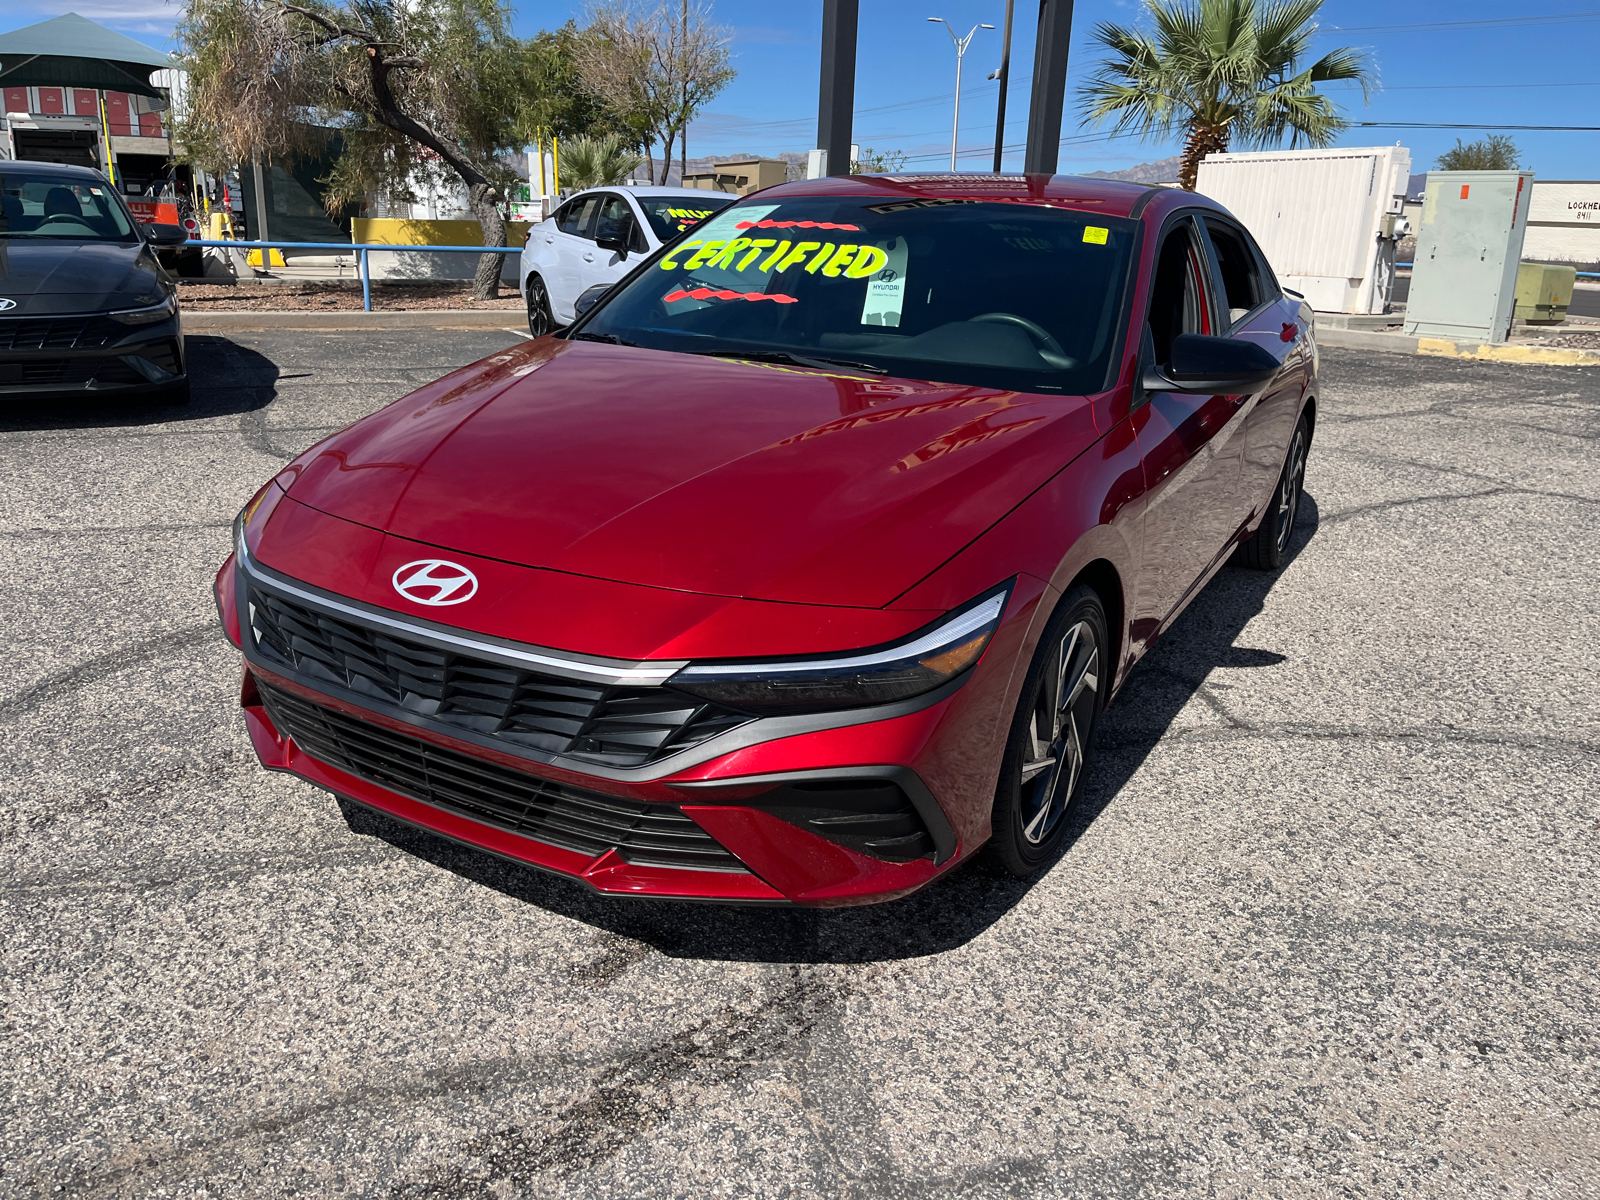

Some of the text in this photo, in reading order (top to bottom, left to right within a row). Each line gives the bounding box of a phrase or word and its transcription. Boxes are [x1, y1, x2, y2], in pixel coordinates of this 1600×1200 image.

[1568, 202, 1600, 210] LOCKHE
[1577, 212, 1591, 220] 8411
[660, 238, 888, 278] CERTIFIED
